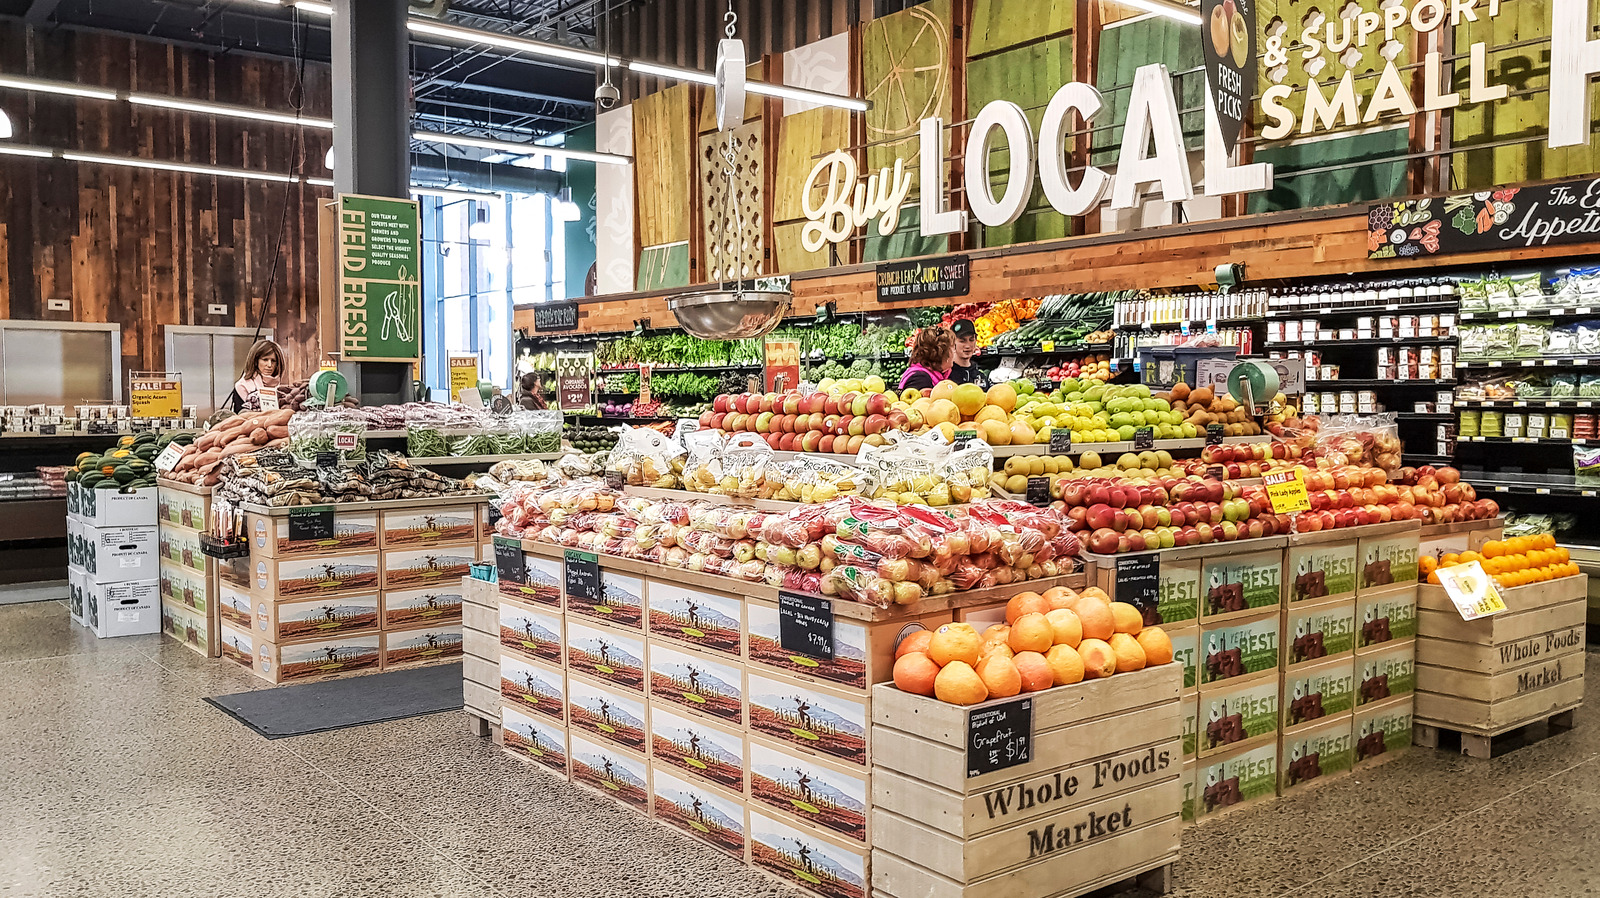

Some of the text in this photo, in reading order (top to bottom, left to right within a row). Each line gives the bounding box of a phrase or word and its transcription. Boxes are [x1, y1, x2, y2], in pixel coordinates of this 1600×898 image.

[1263, 35, 1288, 68] &
[1217, 63, 1242, 96] FRESH
[1261, 42, 1509, 140] SMALL
[1217, 87, 1242, 121] PICKS
[801, 62, 1275, 253] Buy LOCAL
[1547, 186, 1577, 206] The
[342, 210, 366, 272] FIELD
[877, 270, 900, 286] CRUNCH
[921, 266, 939, 284] JUICY
[944, 264, 966, 280] SWEET
[881, 286, 889, 296] OUR
[890, 284, 905, 295] PRODUCE
[907, 284, 911, 293] IS
[928, 282, 939, 291] READY
[940, 281, 946, 290] TO
[946, 280, 954, 290] EAT
[344, 281, 368, 351] FRESH
[133, 382, 161, 390] SALE!
[801, 459, 844, 476] ORGANIC
[1265, 471, 1286, 485] SALE!
[1324, 557, 1354, 576] BEST
[1390, 548, 1417, 566] BEST
[1242, 568, 1278, 589] BEST
[669, 609, 718, 631] FIELD FRESH
[1389, 604, 1415, 622] BEST
[1323, 617, 1352, 637] BEST
[1240, 631, 1276, 654] BEST
[1500, 629, 1580, 664] Whole Foods
[1387, 660, 1413, 679] BEST
[1517, 659, 1562, 692] Market
[670, 674, 719, 698] FIELD FRESH
[1321, 676, 1351, 697] BEST
[971, 709, 1000, 720] CONVENTIONAL
[1241, 695, 1276, 719] BEST
[774, 706, 836, 736] FIELD FRESH
[1384, 715, 1411, 734] BEST
[974, 728, 1015, 749] Grapefruit
[1319, 735, 1350, 757] BEST
[672, 738, 720, 765] FIELD FRESH
[1238, 757, 1274, 782] BEST
[775, 778, 836, 810] FIELD FRESH
[983, 748, 1170, 819] Whole Foods
[675, 801, 723, 830] FIELD FRESH
[1027, 802, 1132, 859] Market
[776, 846, 837, 881] FIELD FRESH
